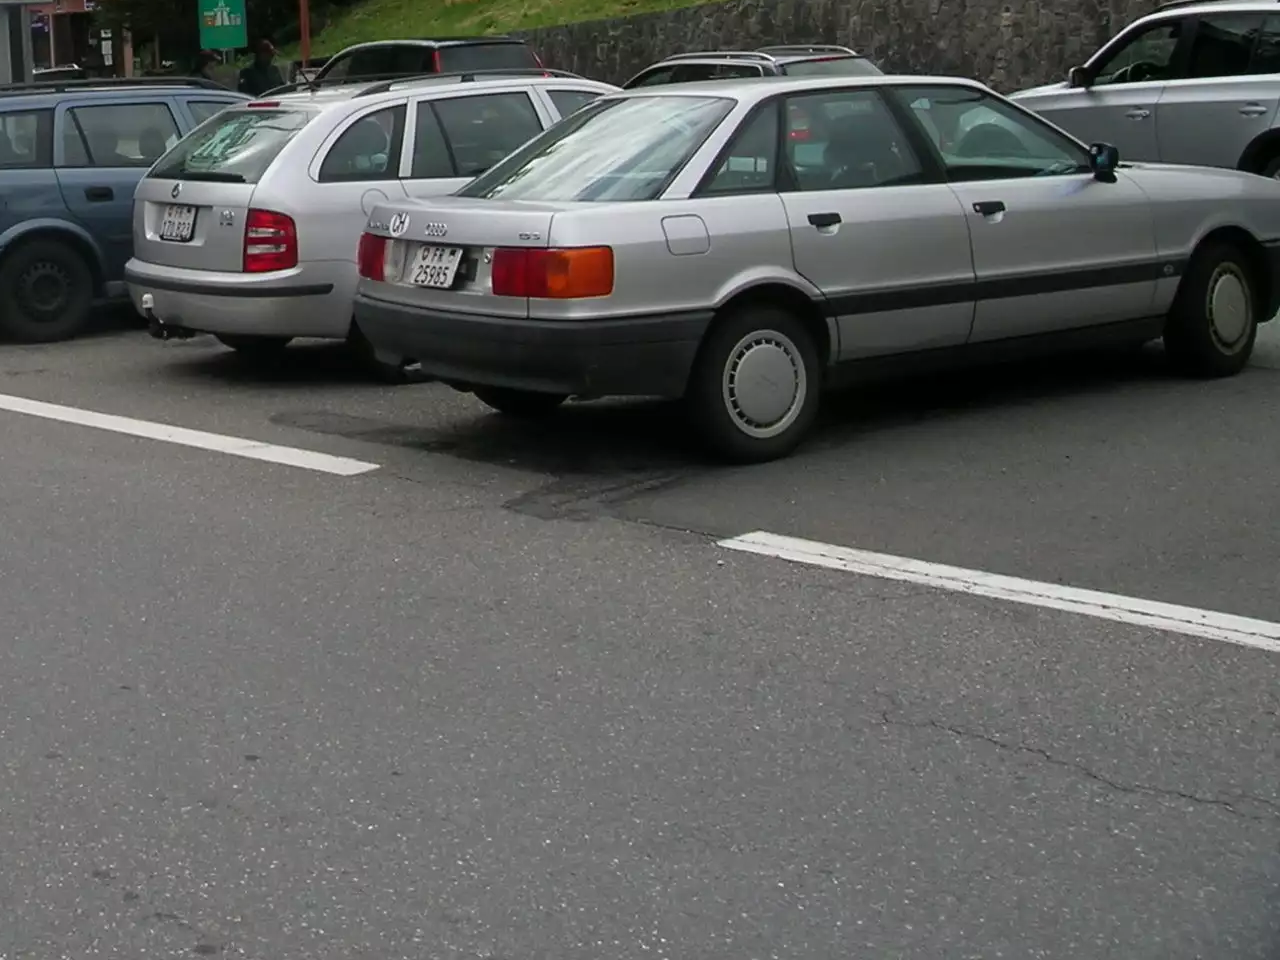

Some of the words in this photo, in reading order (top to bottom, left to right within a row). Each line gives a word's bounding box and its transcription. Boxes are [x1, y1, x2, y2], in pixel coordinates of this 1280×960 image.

[392, 212, 409, 233] CH
[431, 247, 445, 262] FR
[414, 264, 449, 285] 25985
